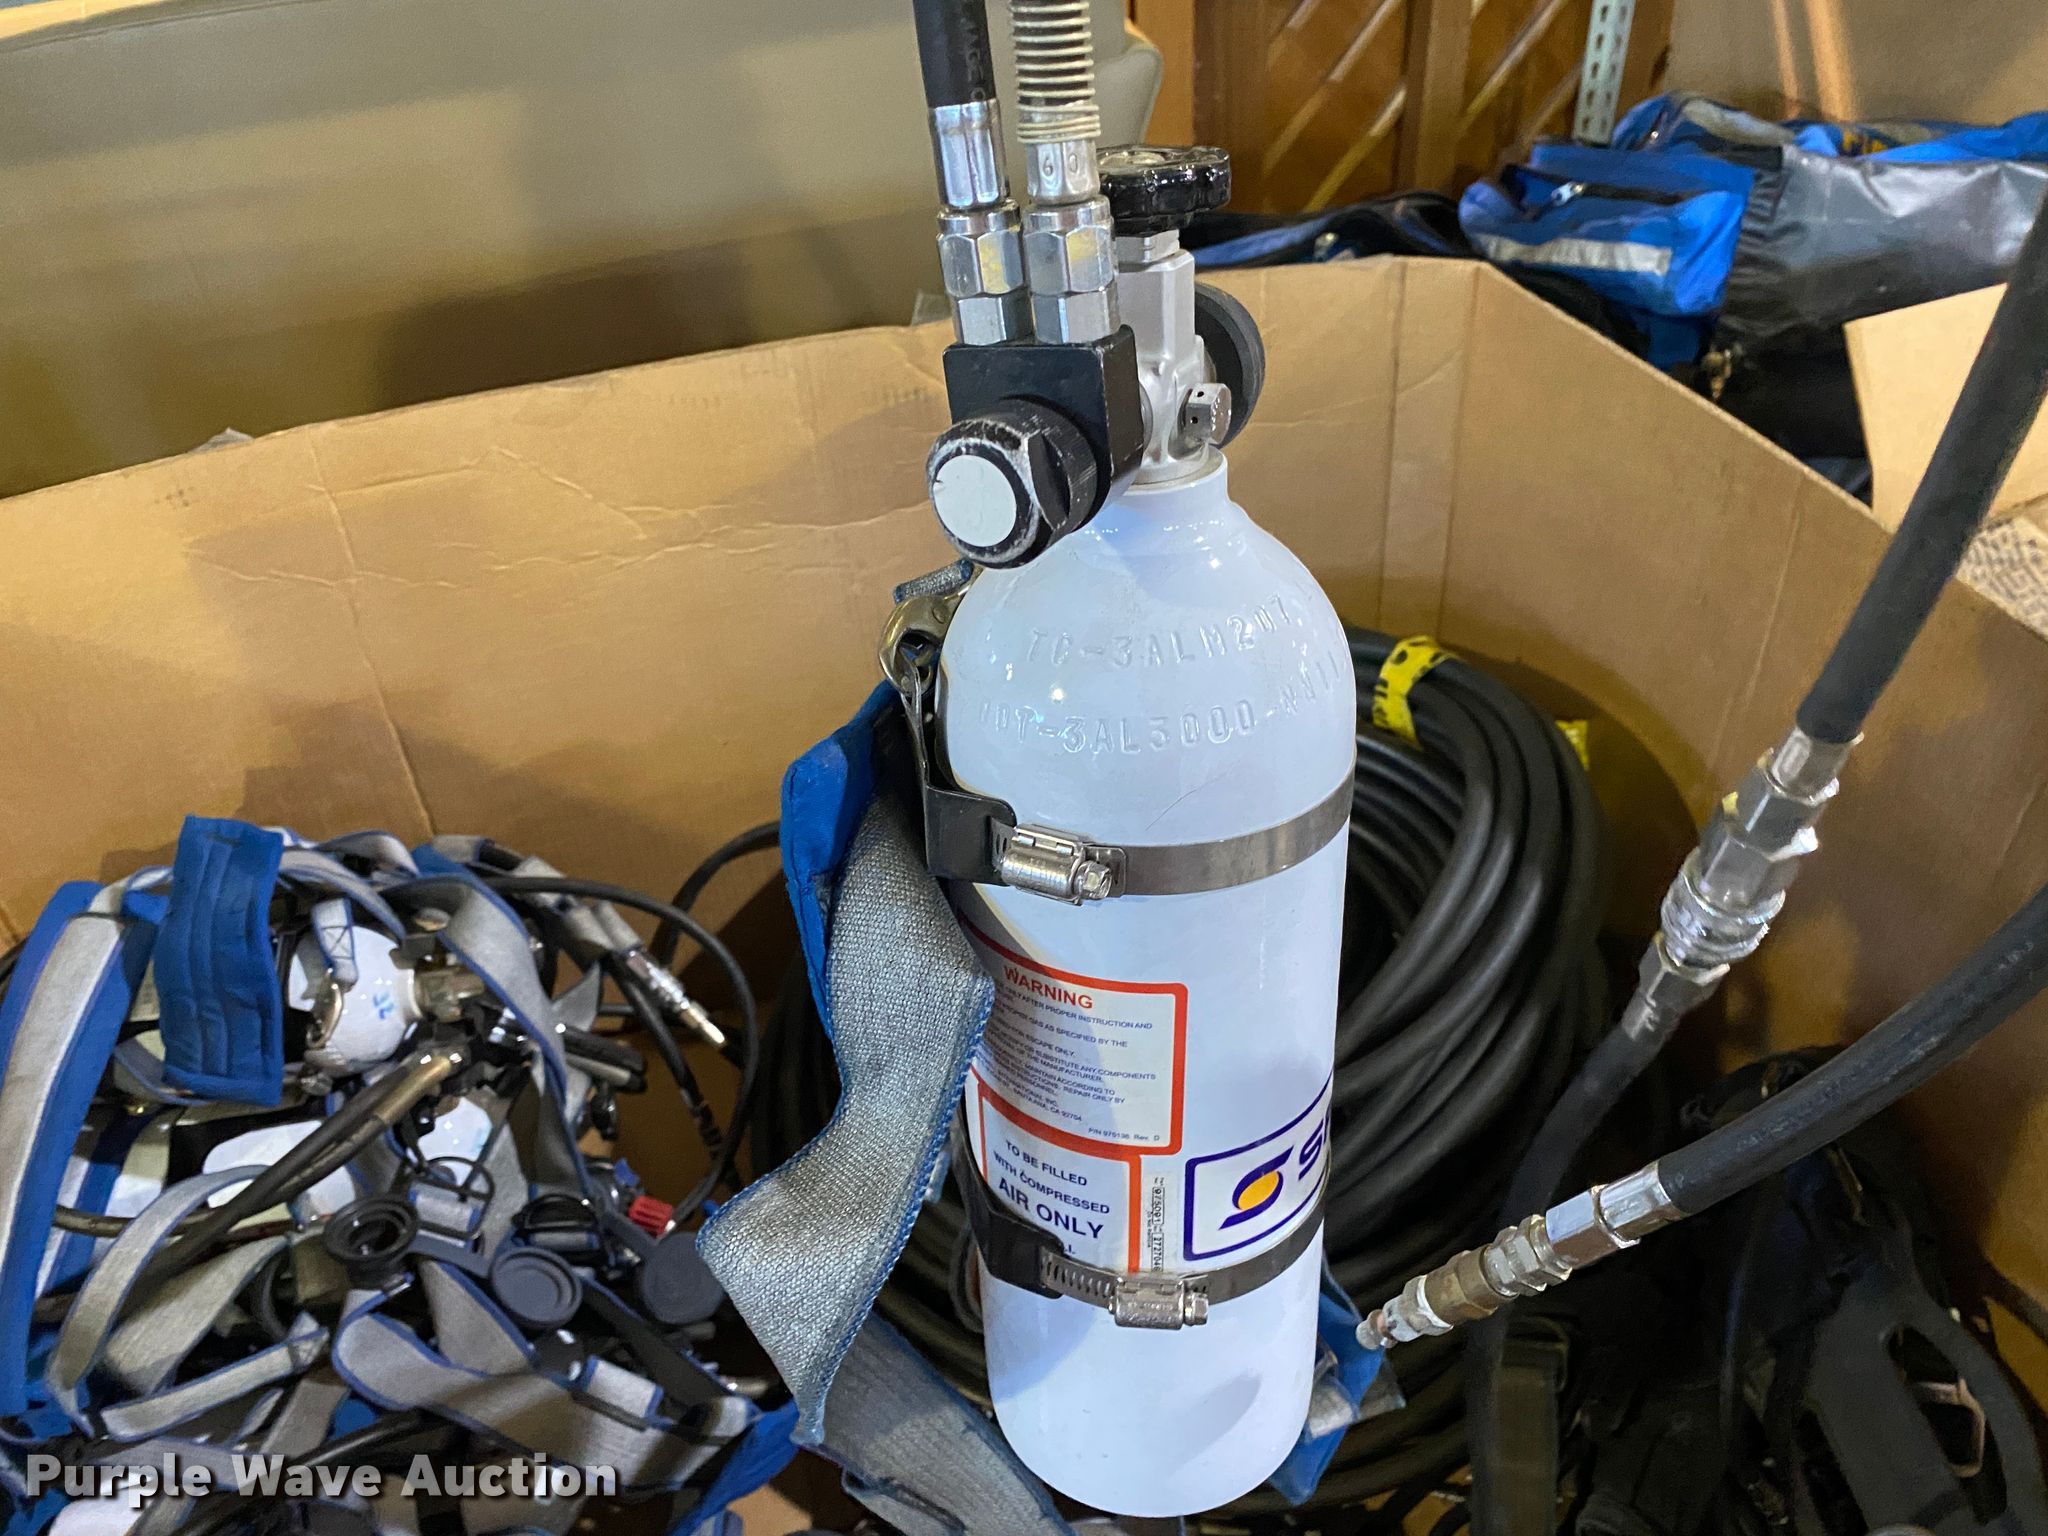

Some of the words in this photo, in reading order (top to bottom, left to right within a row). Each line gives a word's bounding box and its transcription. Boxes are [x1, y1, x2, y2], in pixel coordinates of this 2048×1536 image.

[1003, 965, 1093, 1009] WARNING
[1045, 1004, 1077, 1019] PROPER
[1078, 1015, 1133, 1029] INSTRUCTION
[1135, 1022, 1153, 1030] AND
[1056, 1028, 1097, 1043] SPECIFIED
[1098, 1038, 1109, 1047] BY
[1111, 1040, 1128, 1048] THE
[1036, 1049, 1079, 1070] SUBSTITUTE
[1080, 1065, 1096, 1073] ANY
[1098, 1068, 1156, 1080] COMPONENTS
[1057, 1076, 1102, 1095] ACCORDING
[1104, 1088, 1115, 1096] TO
[1063, 1086, 1091, 1098] REPAIR
[1092, 1094, 1113, 1102] ONLY
[1050, 1107, 1060, 1115] CA
[1005, 1140, 1020, 1157] TO
[1023, 1152, 1039, 1168] BE
[1042, 1163, 1087, 1186] FILLED
[993, 1150, 1017, 1176] WITH
[1019, 1171, 1110, 1214] COMPRESSED
[999, 1177, 1031, 1211] AIR
[1036, 1203, 1104, 1239] ONLY
